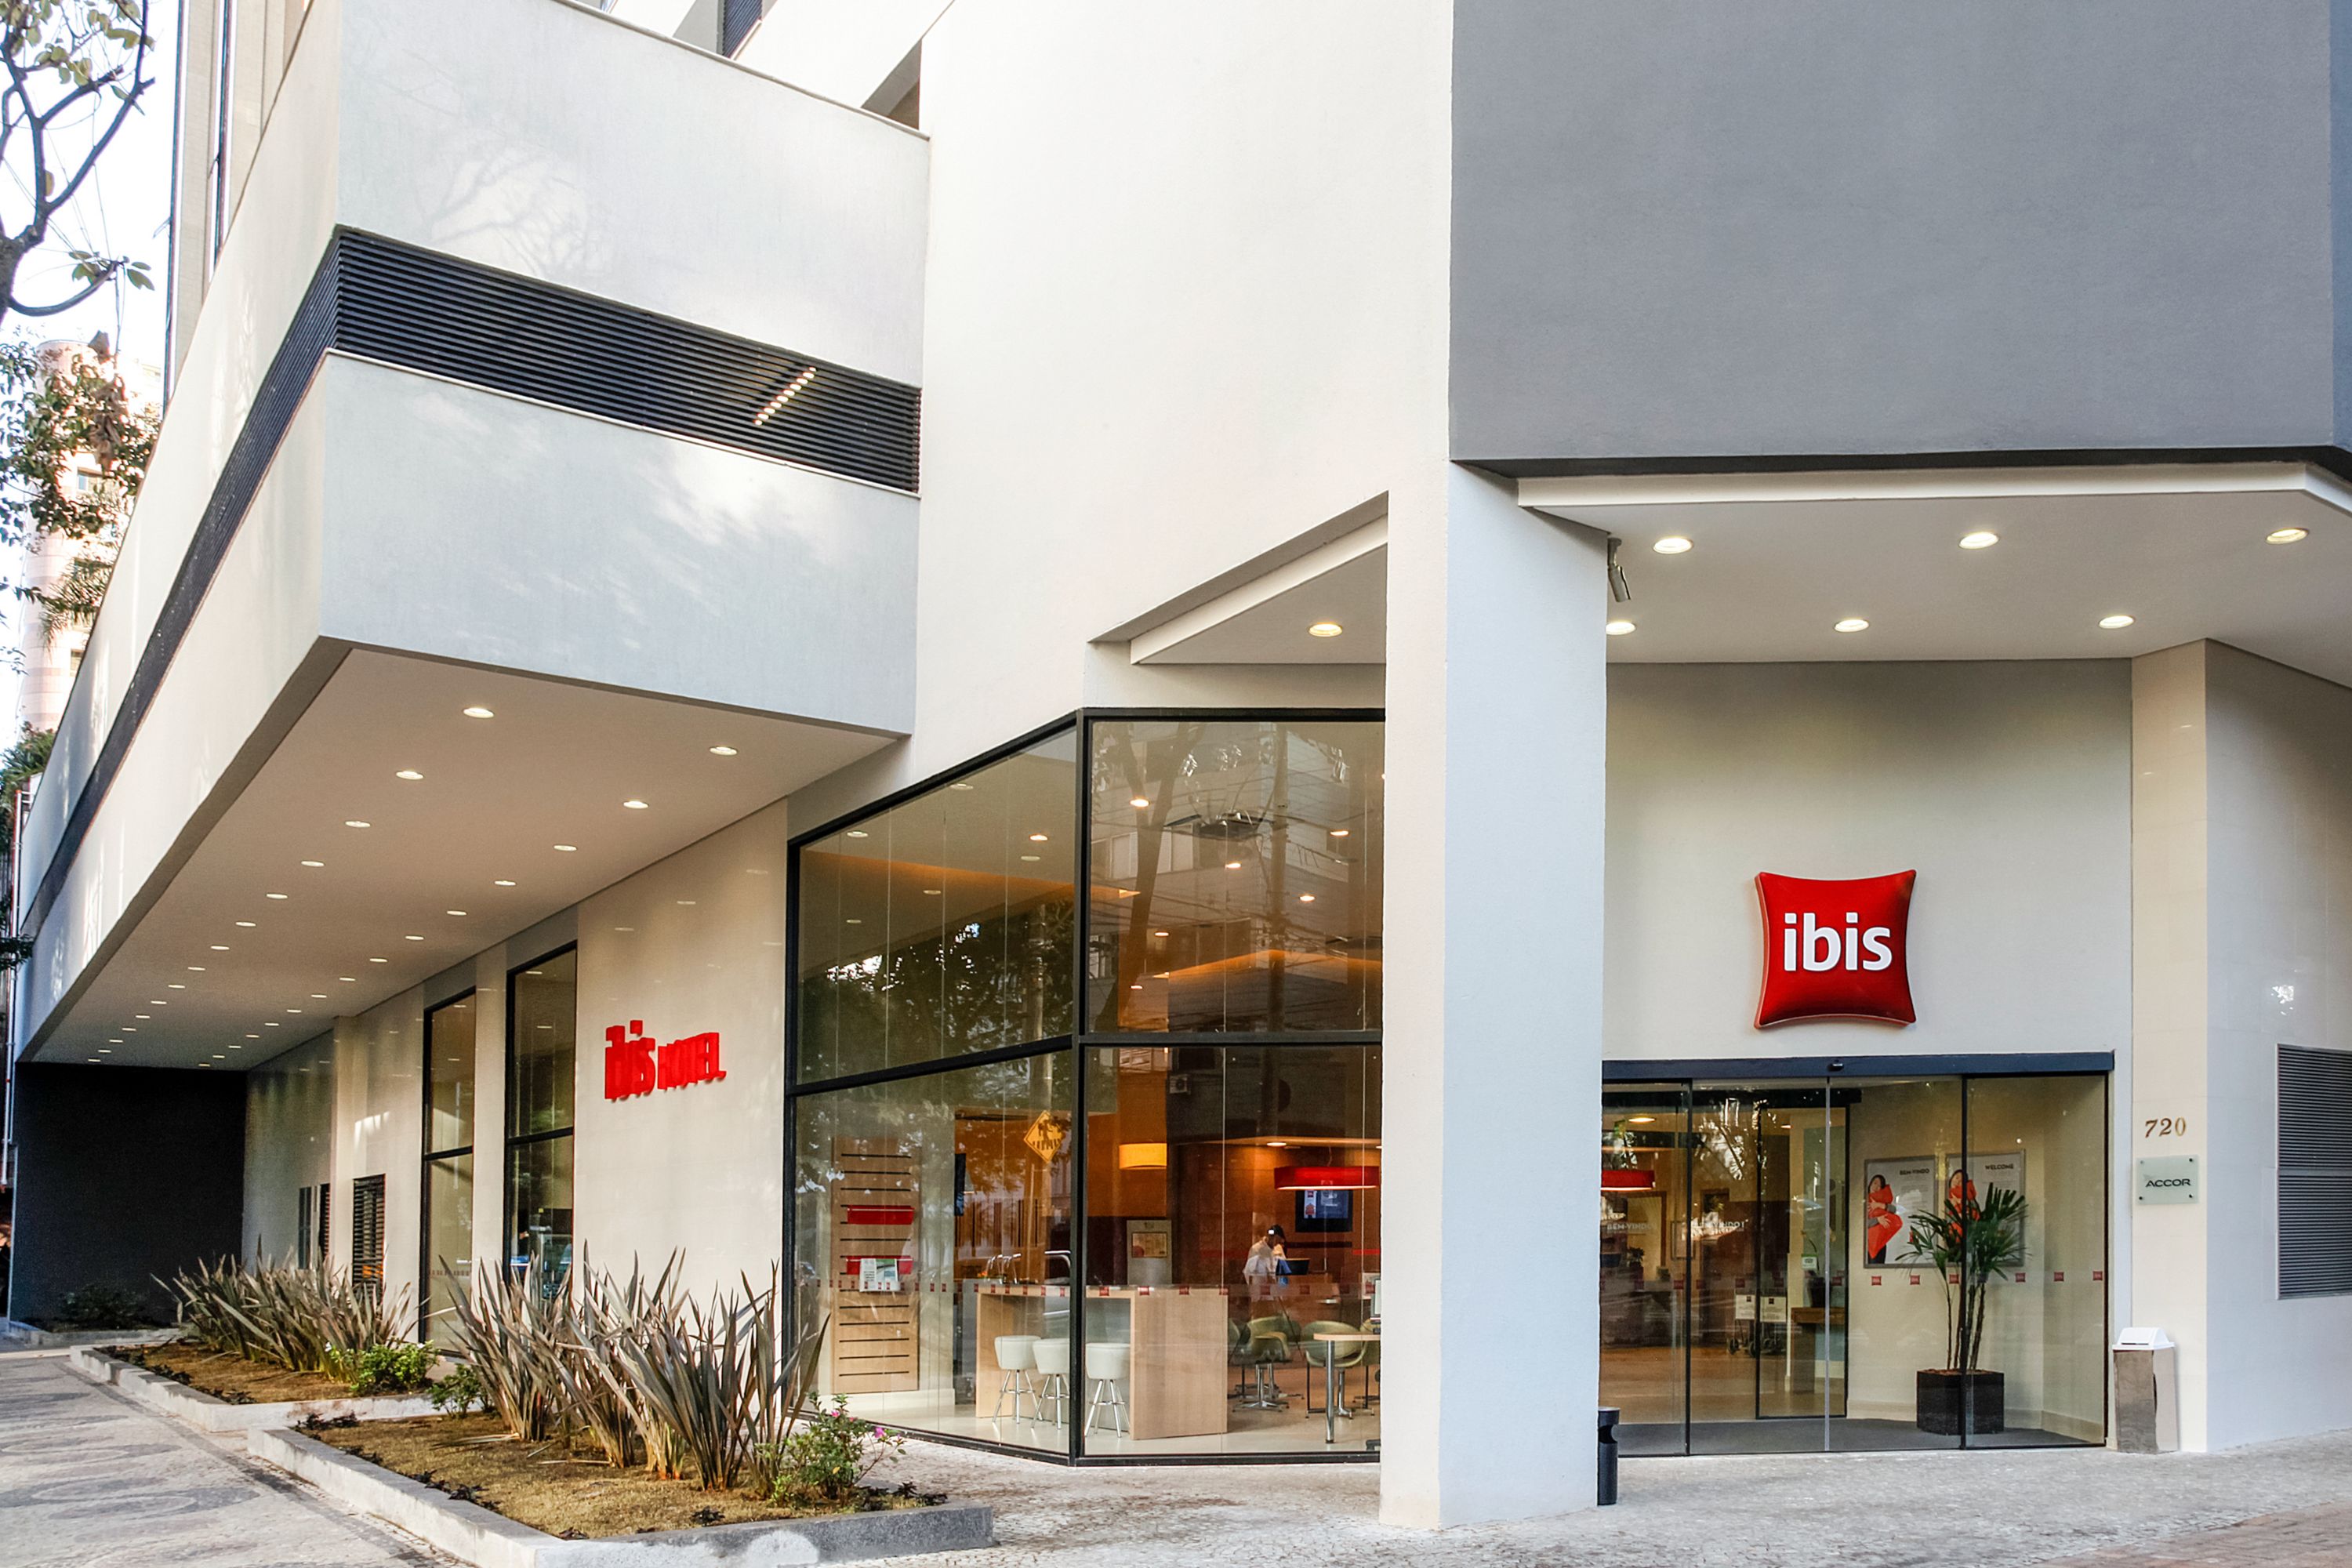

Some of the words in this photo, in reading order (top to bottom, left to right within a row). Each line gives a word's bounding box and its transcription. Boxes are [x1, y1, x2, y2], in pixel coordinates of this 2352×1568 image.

[1784, 912, 1893, 971] ibis
[2145, 1117, 2186, 1138] 720
[2145, 1178, 2190, 1187] ACCOR
